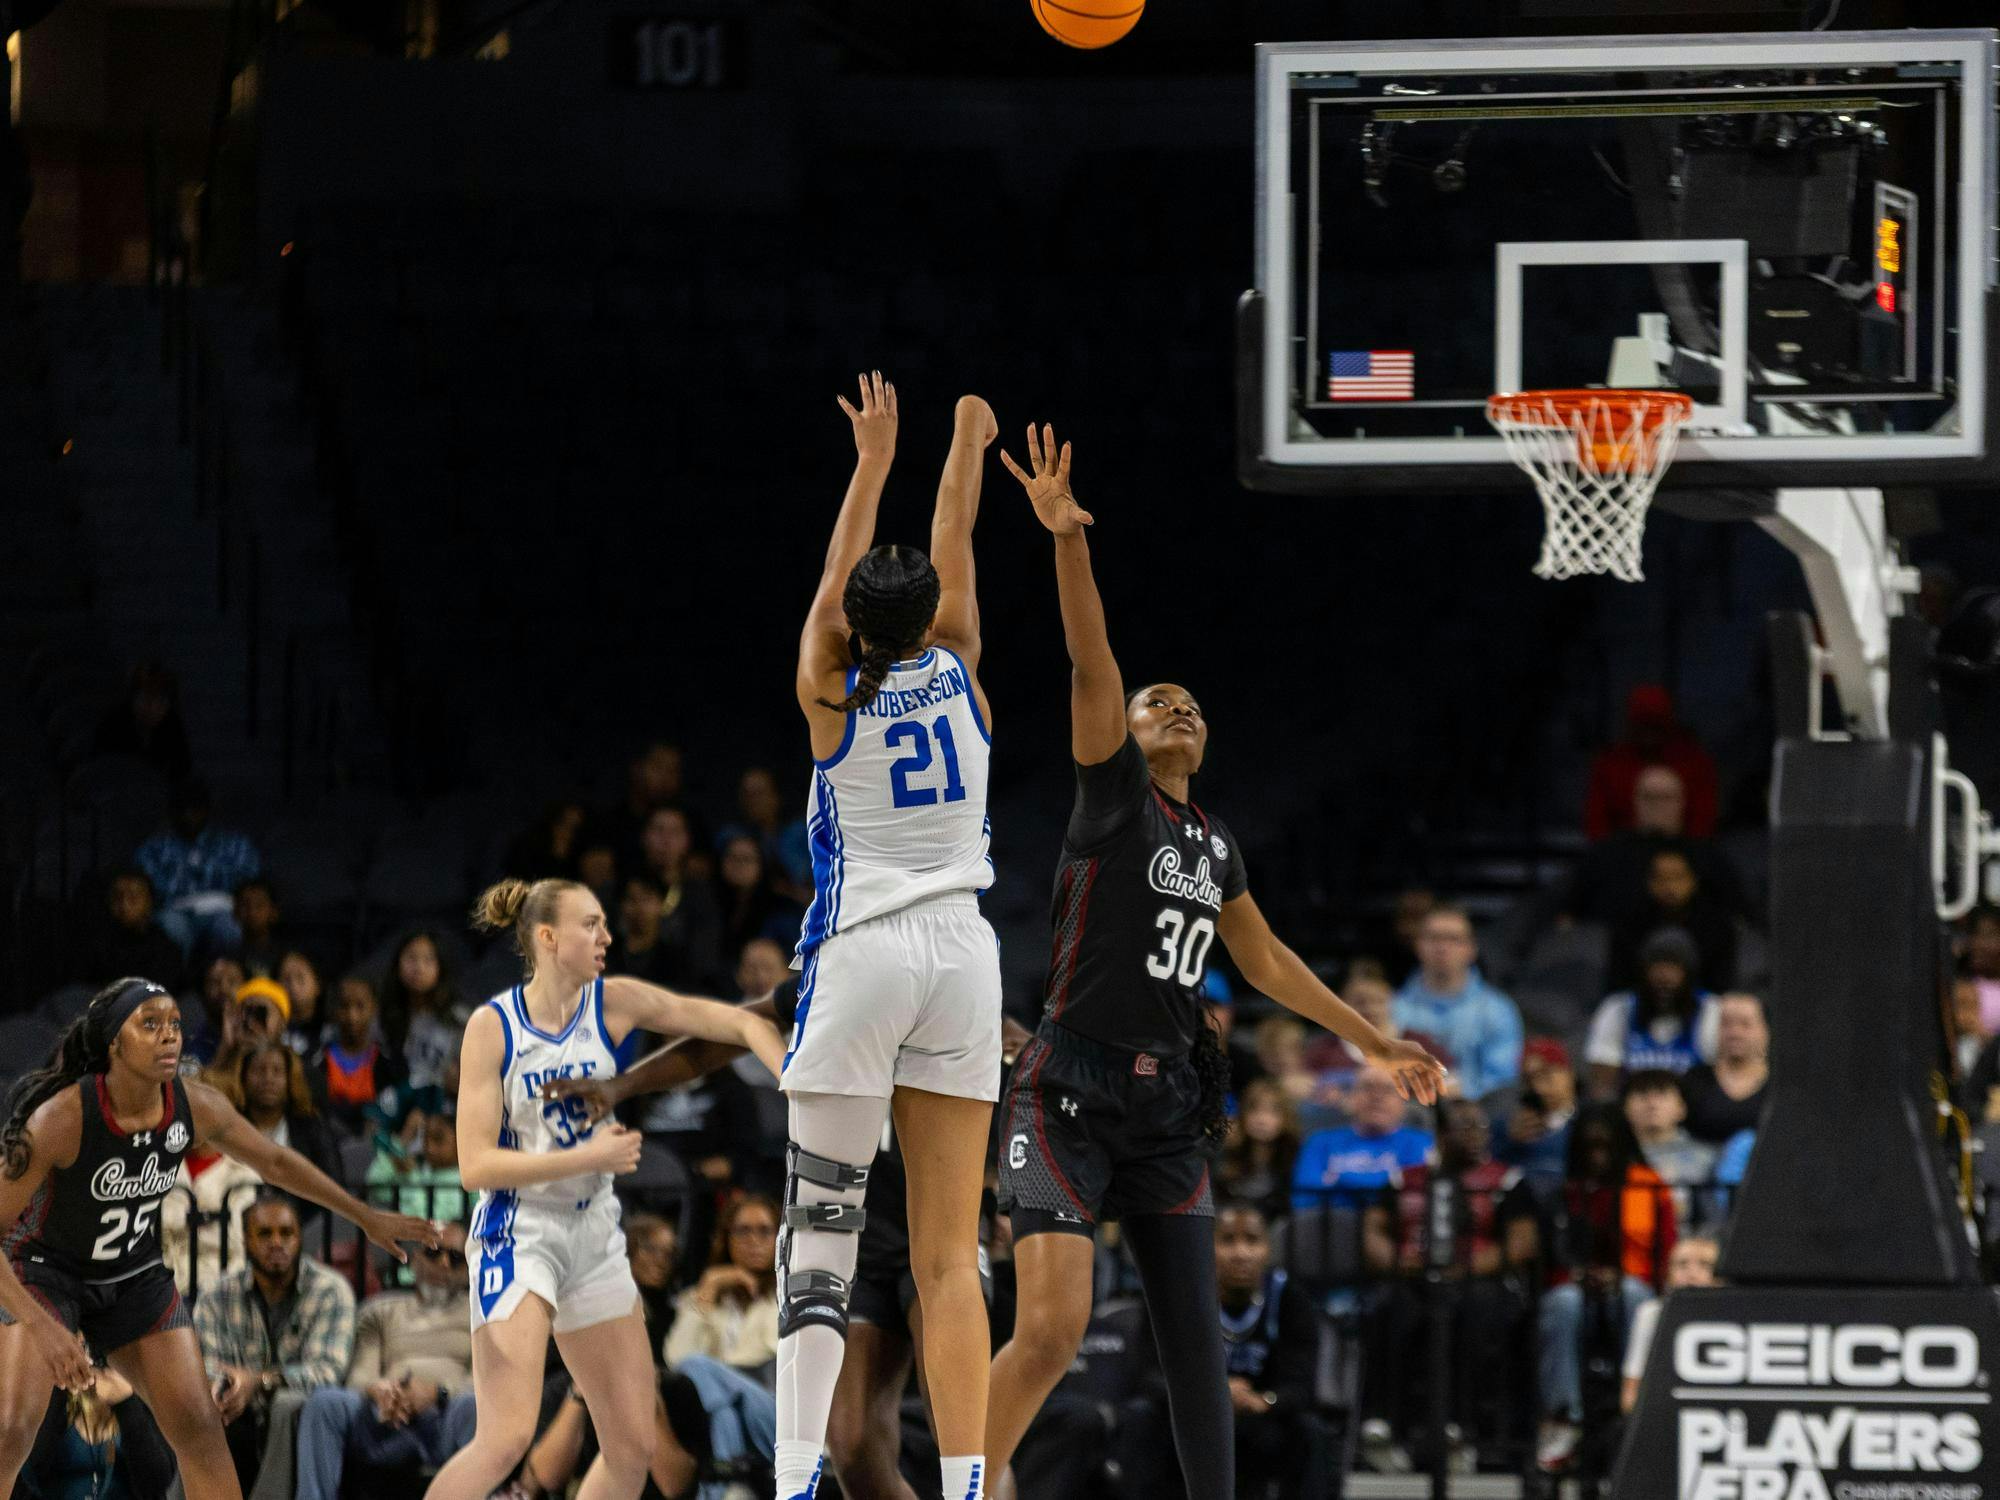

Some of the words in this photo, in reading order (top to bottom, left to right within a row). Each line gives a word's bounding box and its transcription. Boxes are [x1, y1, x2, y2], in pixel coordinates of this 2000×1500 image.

[636, 22, 723, 86] 101
[884, 715, 967, 809] 21
[1146, 908, 1215, 988] 30
[543, 1095, 594, 1148] 35
[91, 1200, 161, 1260] 25
[1674, 1322, 1980, 1388] GEICO
[1678, 1407, 1983, 1473] PLAYERS
